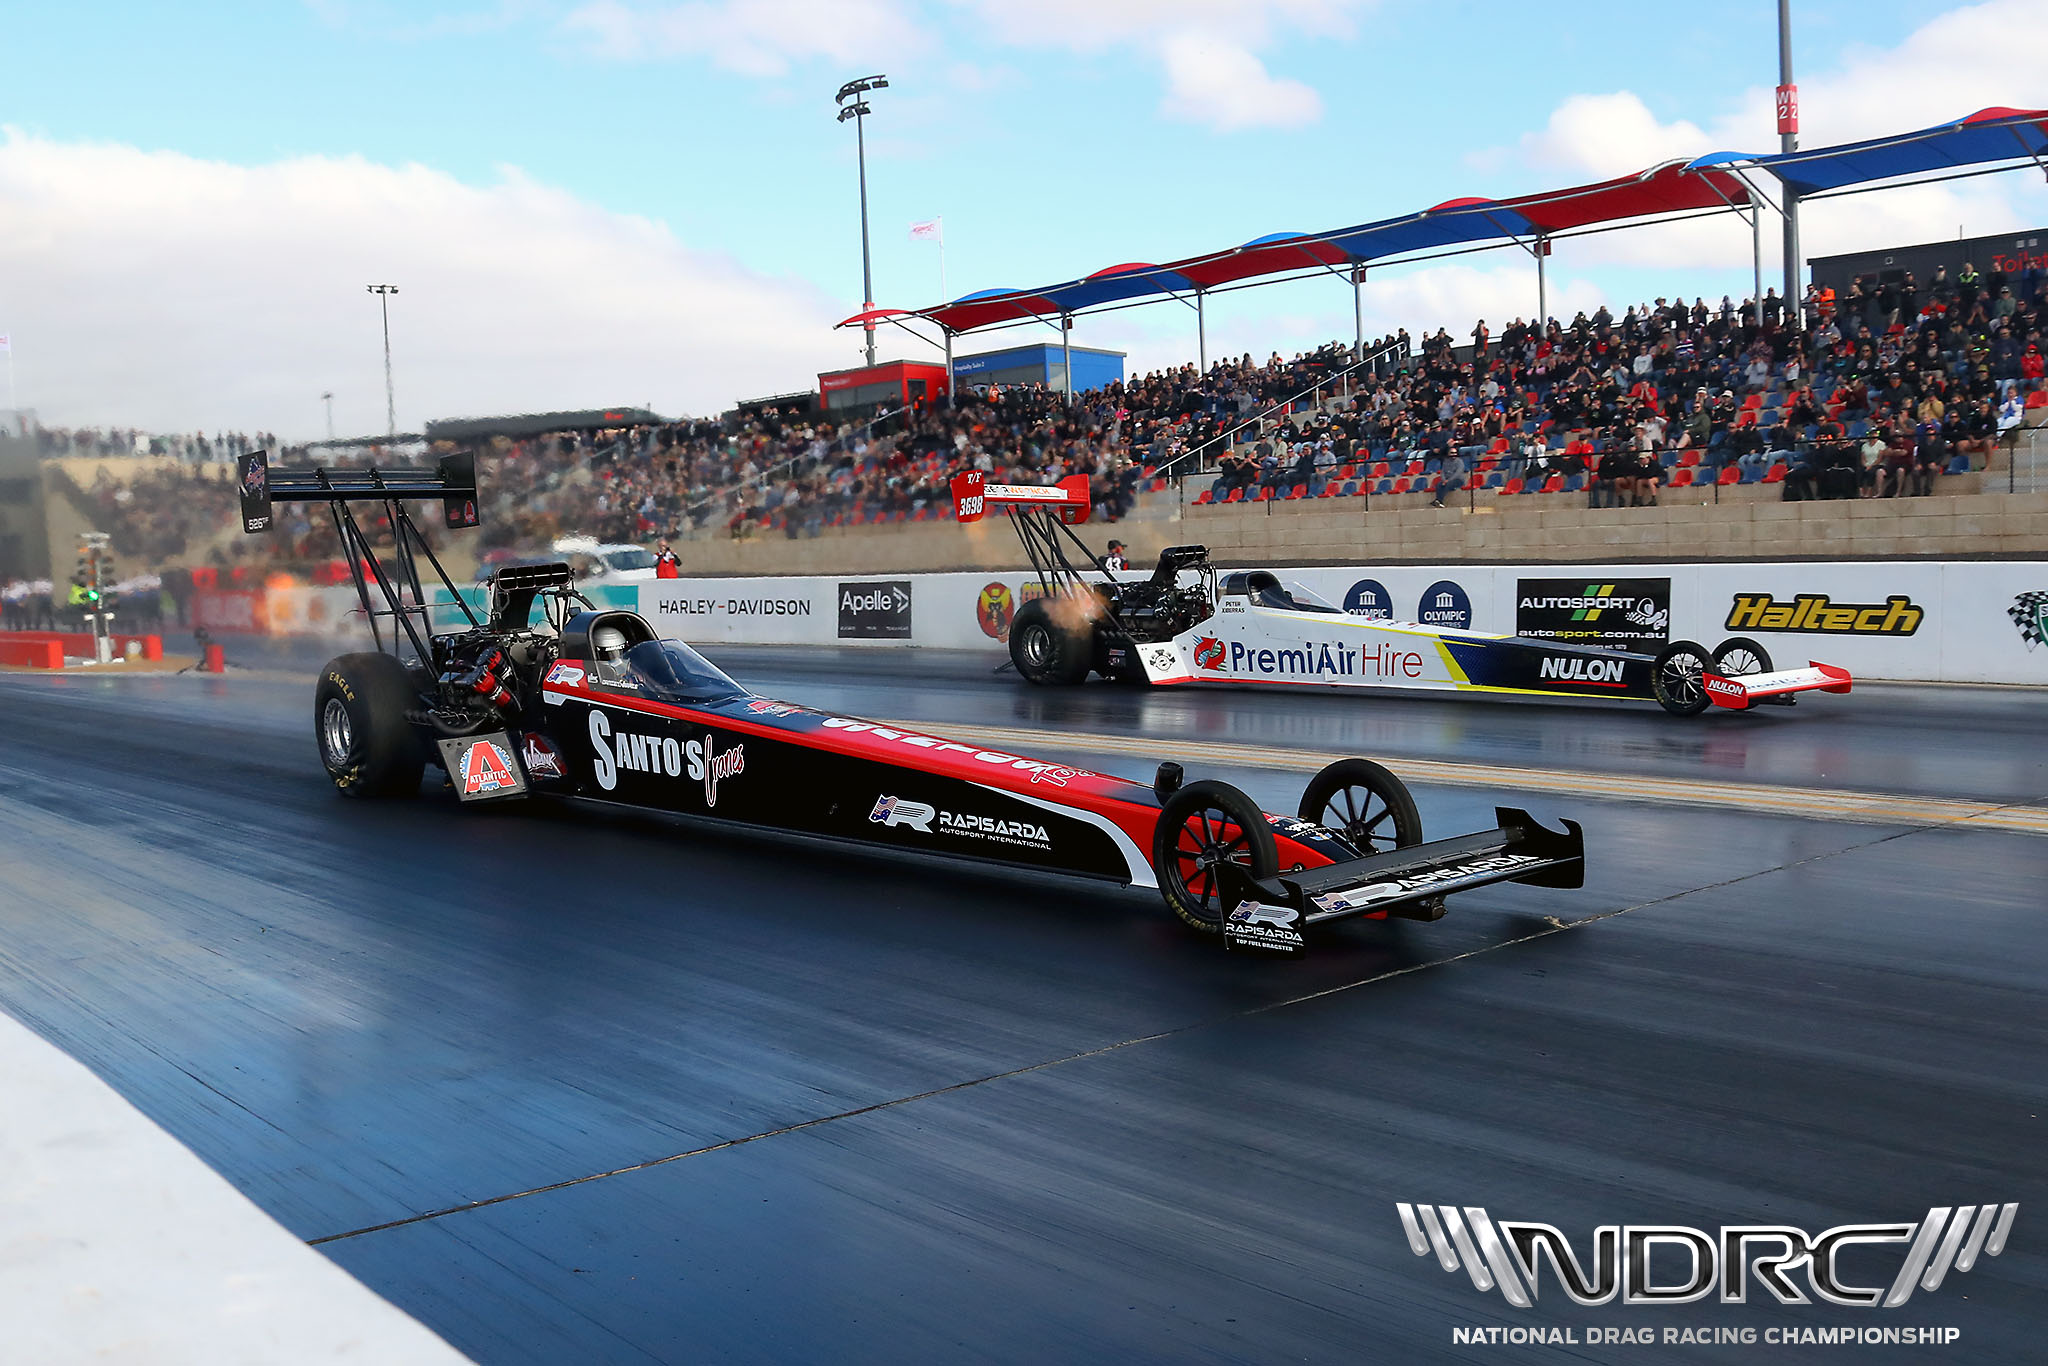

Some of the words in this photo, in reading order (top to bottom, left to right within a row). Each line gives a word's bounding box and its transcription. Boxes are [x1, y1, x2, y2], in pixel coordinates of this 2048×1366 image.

[959, 496, 984, 516] 3698
[1105, 557, 1121, 571] 43
[841, 590, 892, 616] Apelle
[1519, 597, 1636, 610] AUTOSPORT
[1424, 610, 1466, 621] OLYMPIC
[1727, 597, 1921, 632] Haltech
[1518, 629, 1667, 639] autosport.com.au
[1540, 657, 1625, 682] NULON
[329, 671, 355, 702] EAGLE
[1708, 679, 1744, 696] NULON
[588, 709, 705, 791] SANTO'S
[469, 769, 508, 785] ATLANTIC
[939, 810, 1051, 842] RAPISARDA
[939, 827, 986, 839] AUTOSPORT
[987, 834, 1052, 851] INTERNATIONAL
[1225, 922, 1304, 942] RAPISARDA
[1236, 938, 1248, 946] TOP
[1248, 940, 1262, 948] FUEL
[1262, 942, 1294, 952] DRAGSTER
